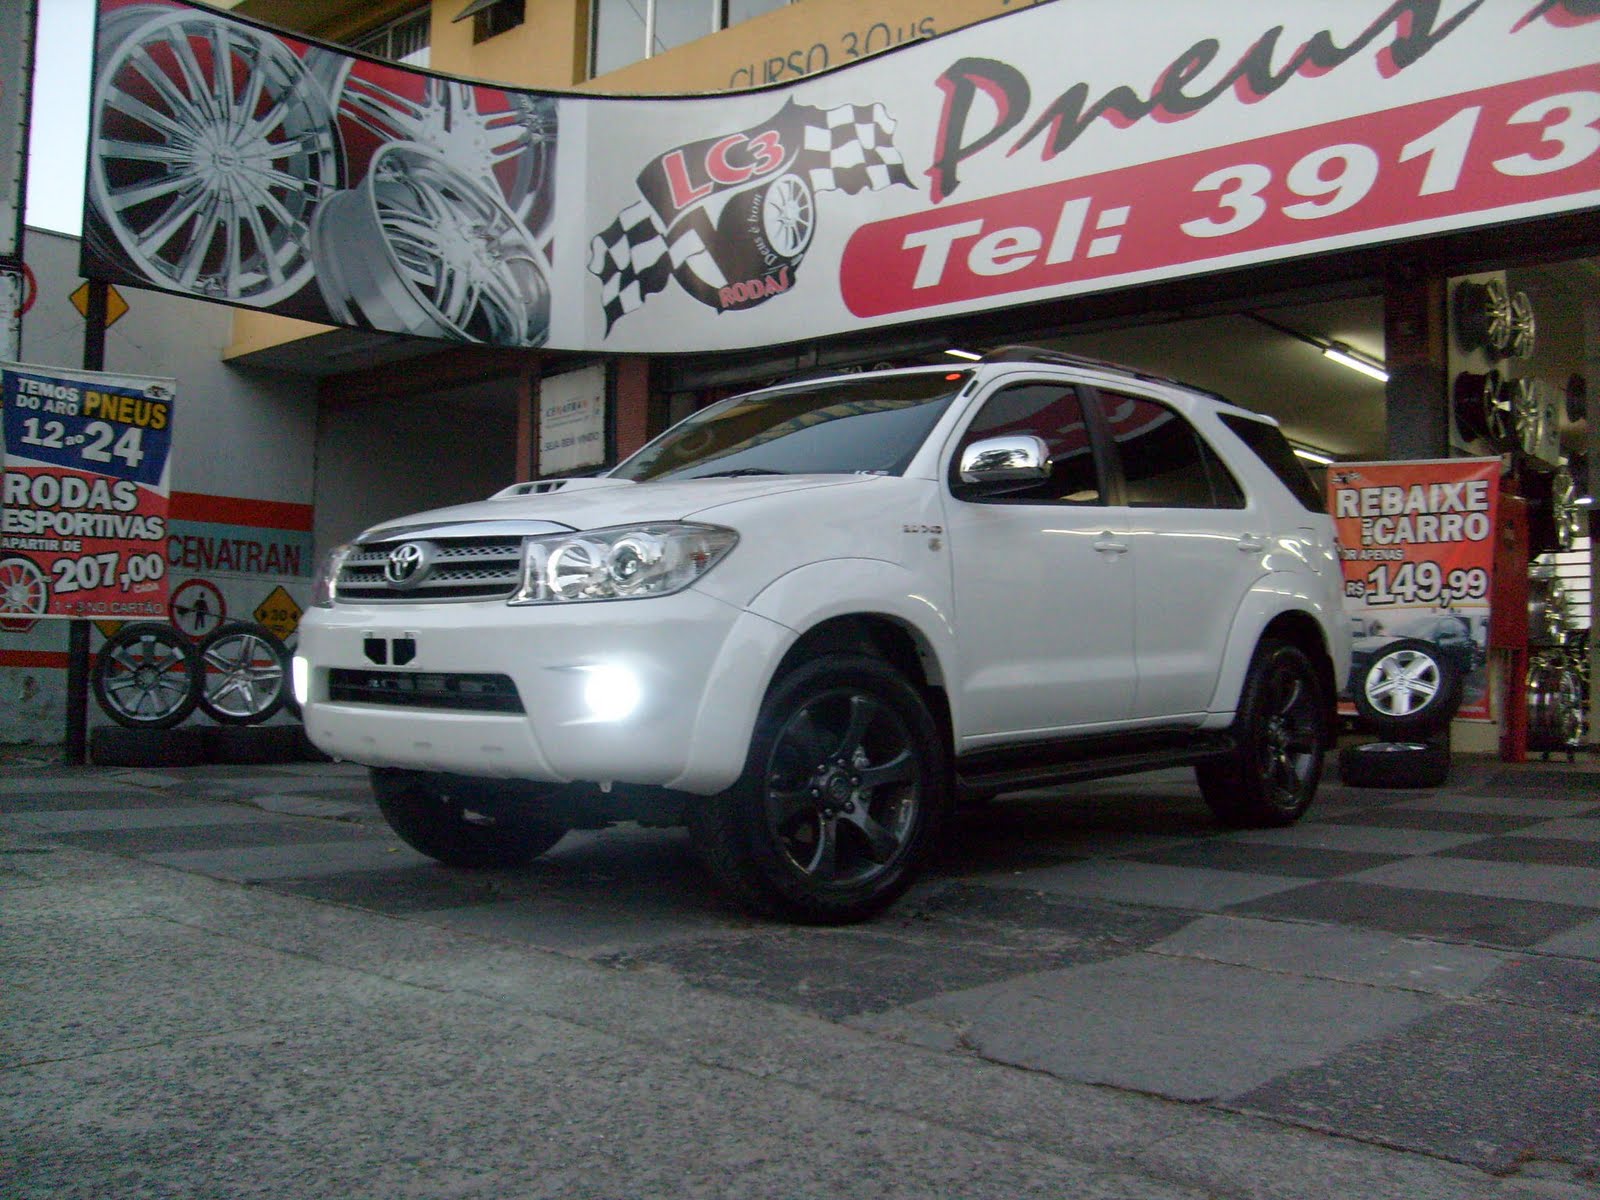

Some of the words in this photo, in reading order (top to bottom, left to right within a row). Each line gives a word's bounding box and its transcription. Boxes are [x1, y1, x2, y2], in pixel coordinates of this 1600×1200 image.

[661, 130, 785, 210] LC3
[902, 197, 1131, 290] Tel:
[1179, 91, 1600, 238] 3913
[747, 193, 763, 223] bom
[718, 265, 790, 309] RODAS
[15, 394, 41, 411] DO
[42, 398, 80, 416] ARO
[17, 378, 80, 402] TEMOS
[83, 390, 168, 430] PNEUS
[21, 417, 65, 449] 12
[81, 421, 145, 468] 24
[3, 472, 138, 512] RODAS
[1336, 480, 1489, 519] REBAIXE
[2, 508, 165, 540] ESPORTIVAS
[1373, 512, 1490, 546] CARRO
[61, 540, 82, 552] DE
[167, 535, 300, 576] CENATRAN
[52, 552, 165, 594] 207,00
[1366, 561, 1489, 608] 149,99
